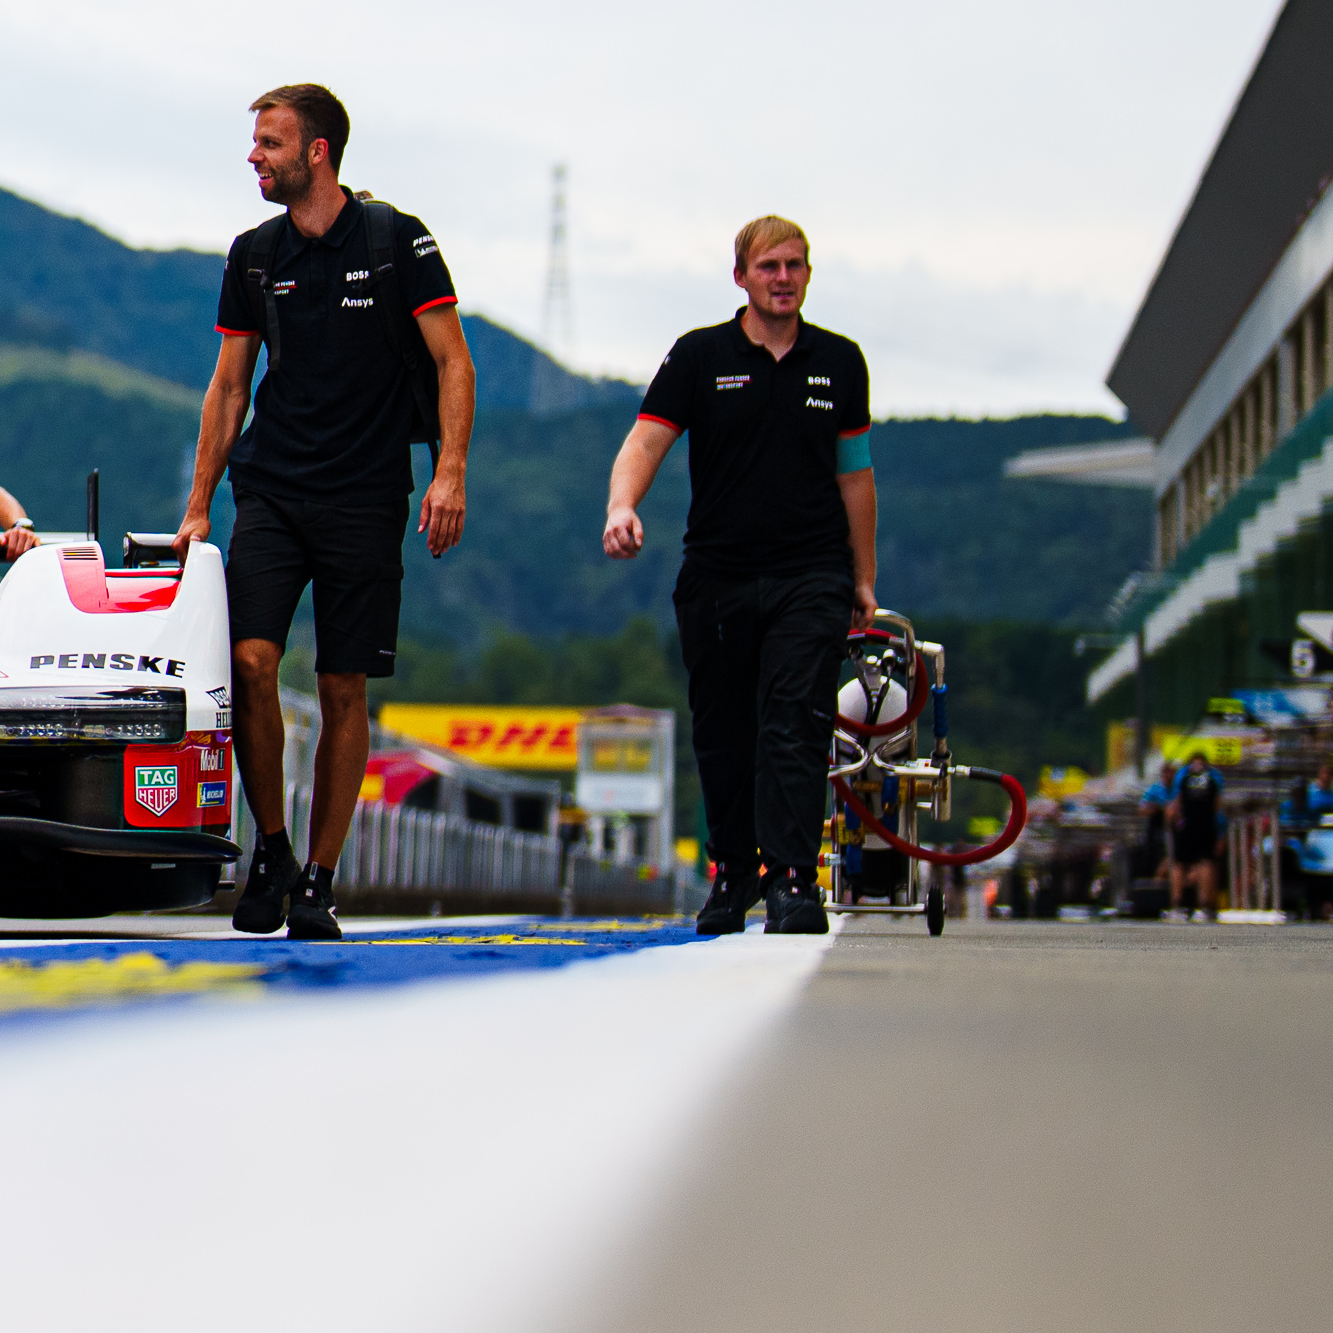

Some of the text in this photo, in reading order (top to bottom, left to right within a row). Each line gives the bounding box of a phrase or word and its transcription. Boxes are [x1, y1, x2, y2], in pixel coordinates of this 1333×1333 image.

[346, 270, 369, 282] BOSS
[342, 297, 373, 308] Ansys
[808, 376, 830, 386] BOSS
[806, 397, 833, 410] Ansys
[30, 653, 186, 678] PENSKE
[449, 719, 576, 755] DHL
[200, 749, 219, 771] Mobil
[139, 770, 174, 785] TAG
[138, 788, 176, 811] HEUER
